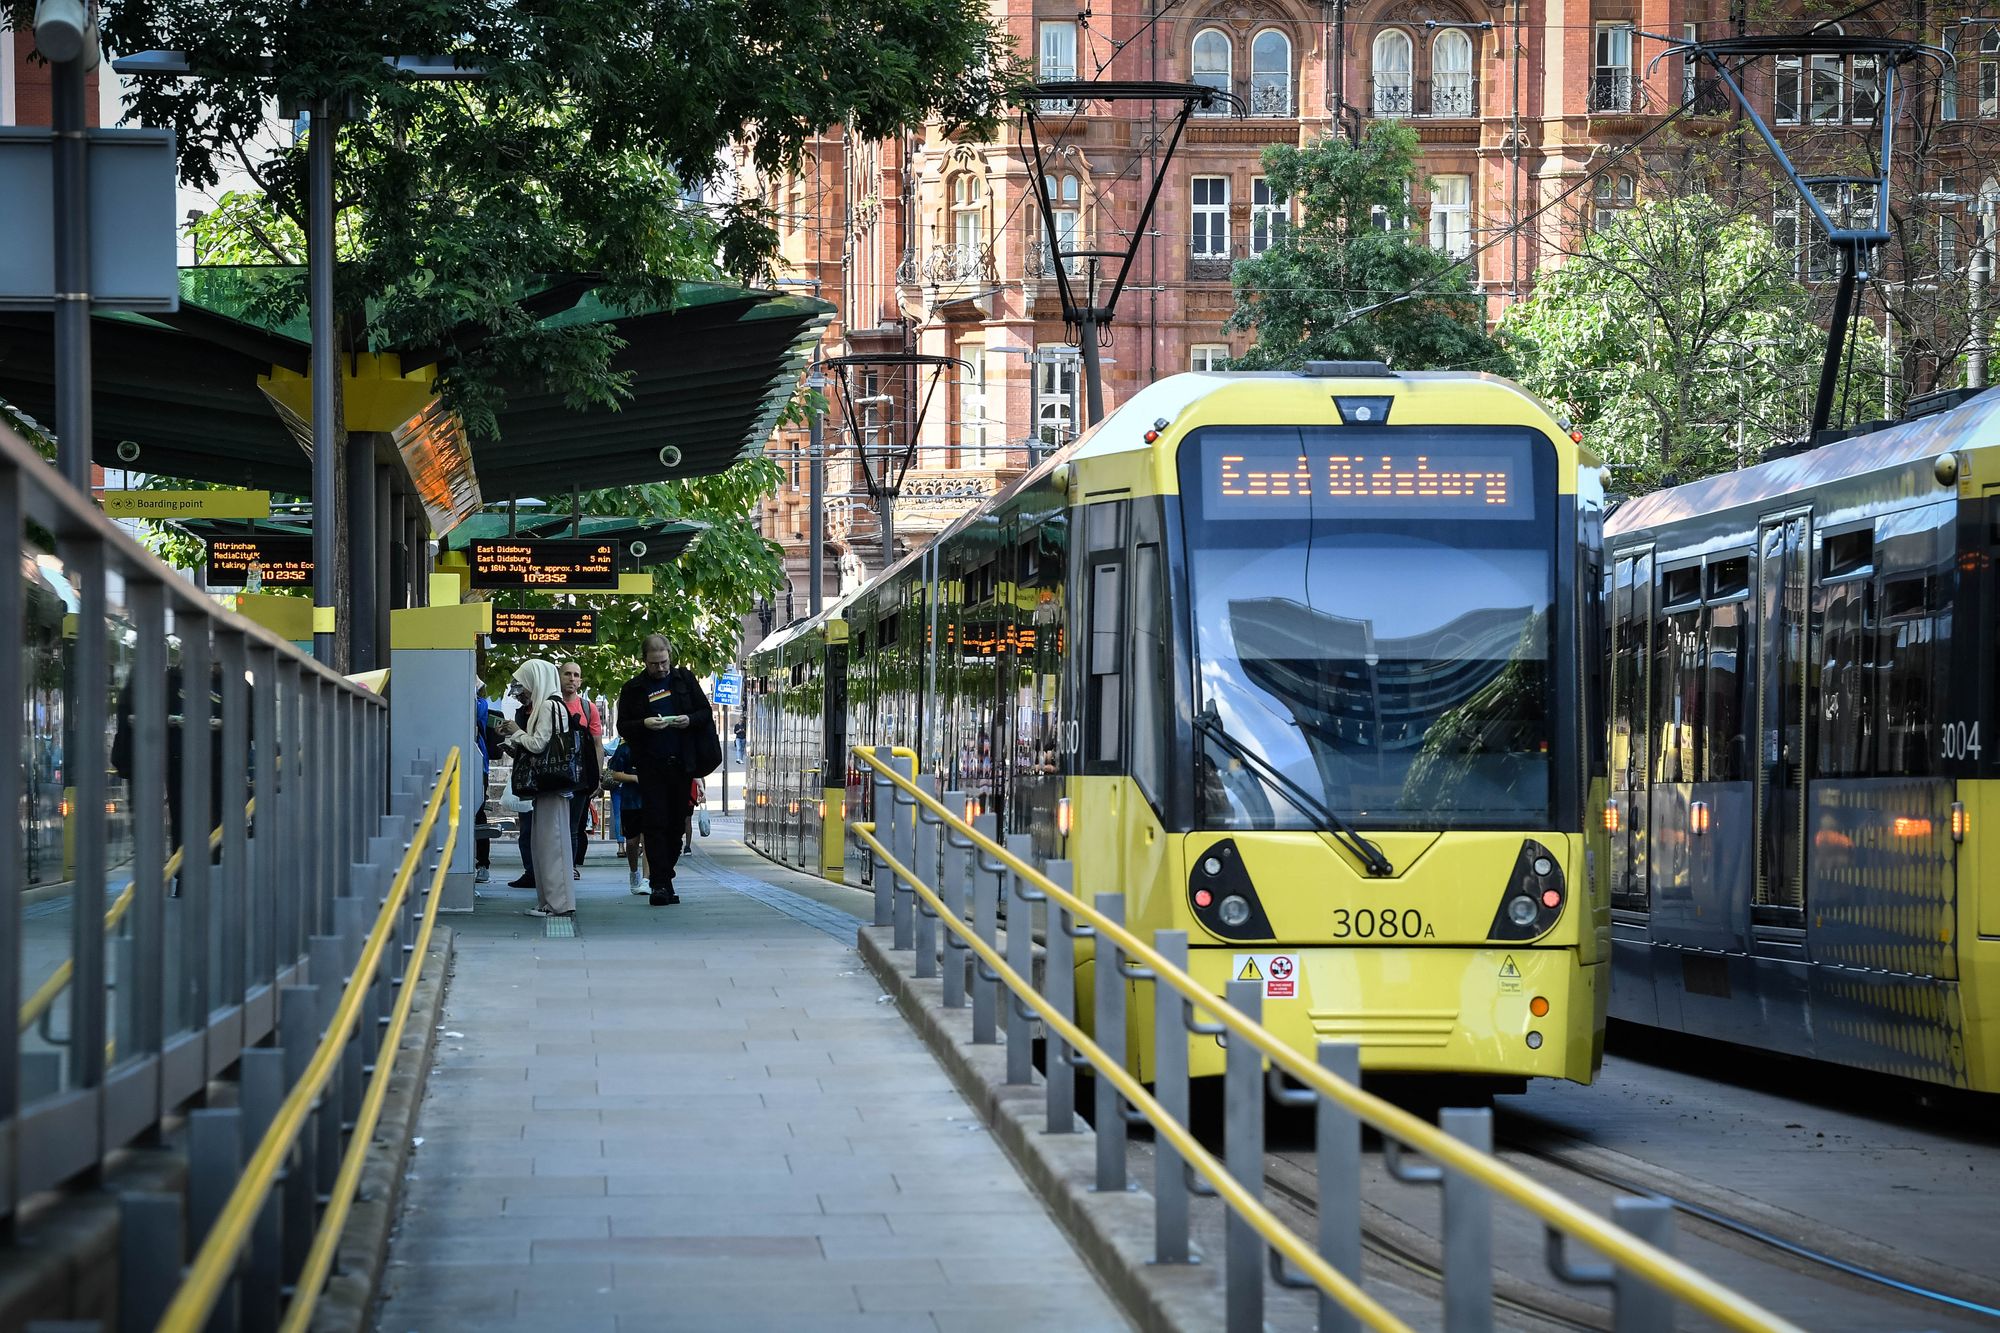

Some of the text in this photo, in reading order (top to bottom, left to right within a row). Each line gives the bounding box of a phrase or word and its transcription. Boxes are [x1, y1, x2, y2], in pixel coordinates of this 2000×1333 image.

[1222, 456, 1506, 503] East Didsbury
[137, 499, 204, 510] Boarding point
[497, 546, 531, 554] Didsbury
[477, 555, 531, 563] East Didsbury
[221, 562, 246, 570] taking
[478, 565, 488, 573] ay
[490, 564, 507, 572] 16th
[509, 564, 527, 573] July
[528, 564, 542, 572] for
[544, 565, 574, 573] approx.
[583, 565, 611, 573] months.
[1941, 720, 1982, 760] 3004
